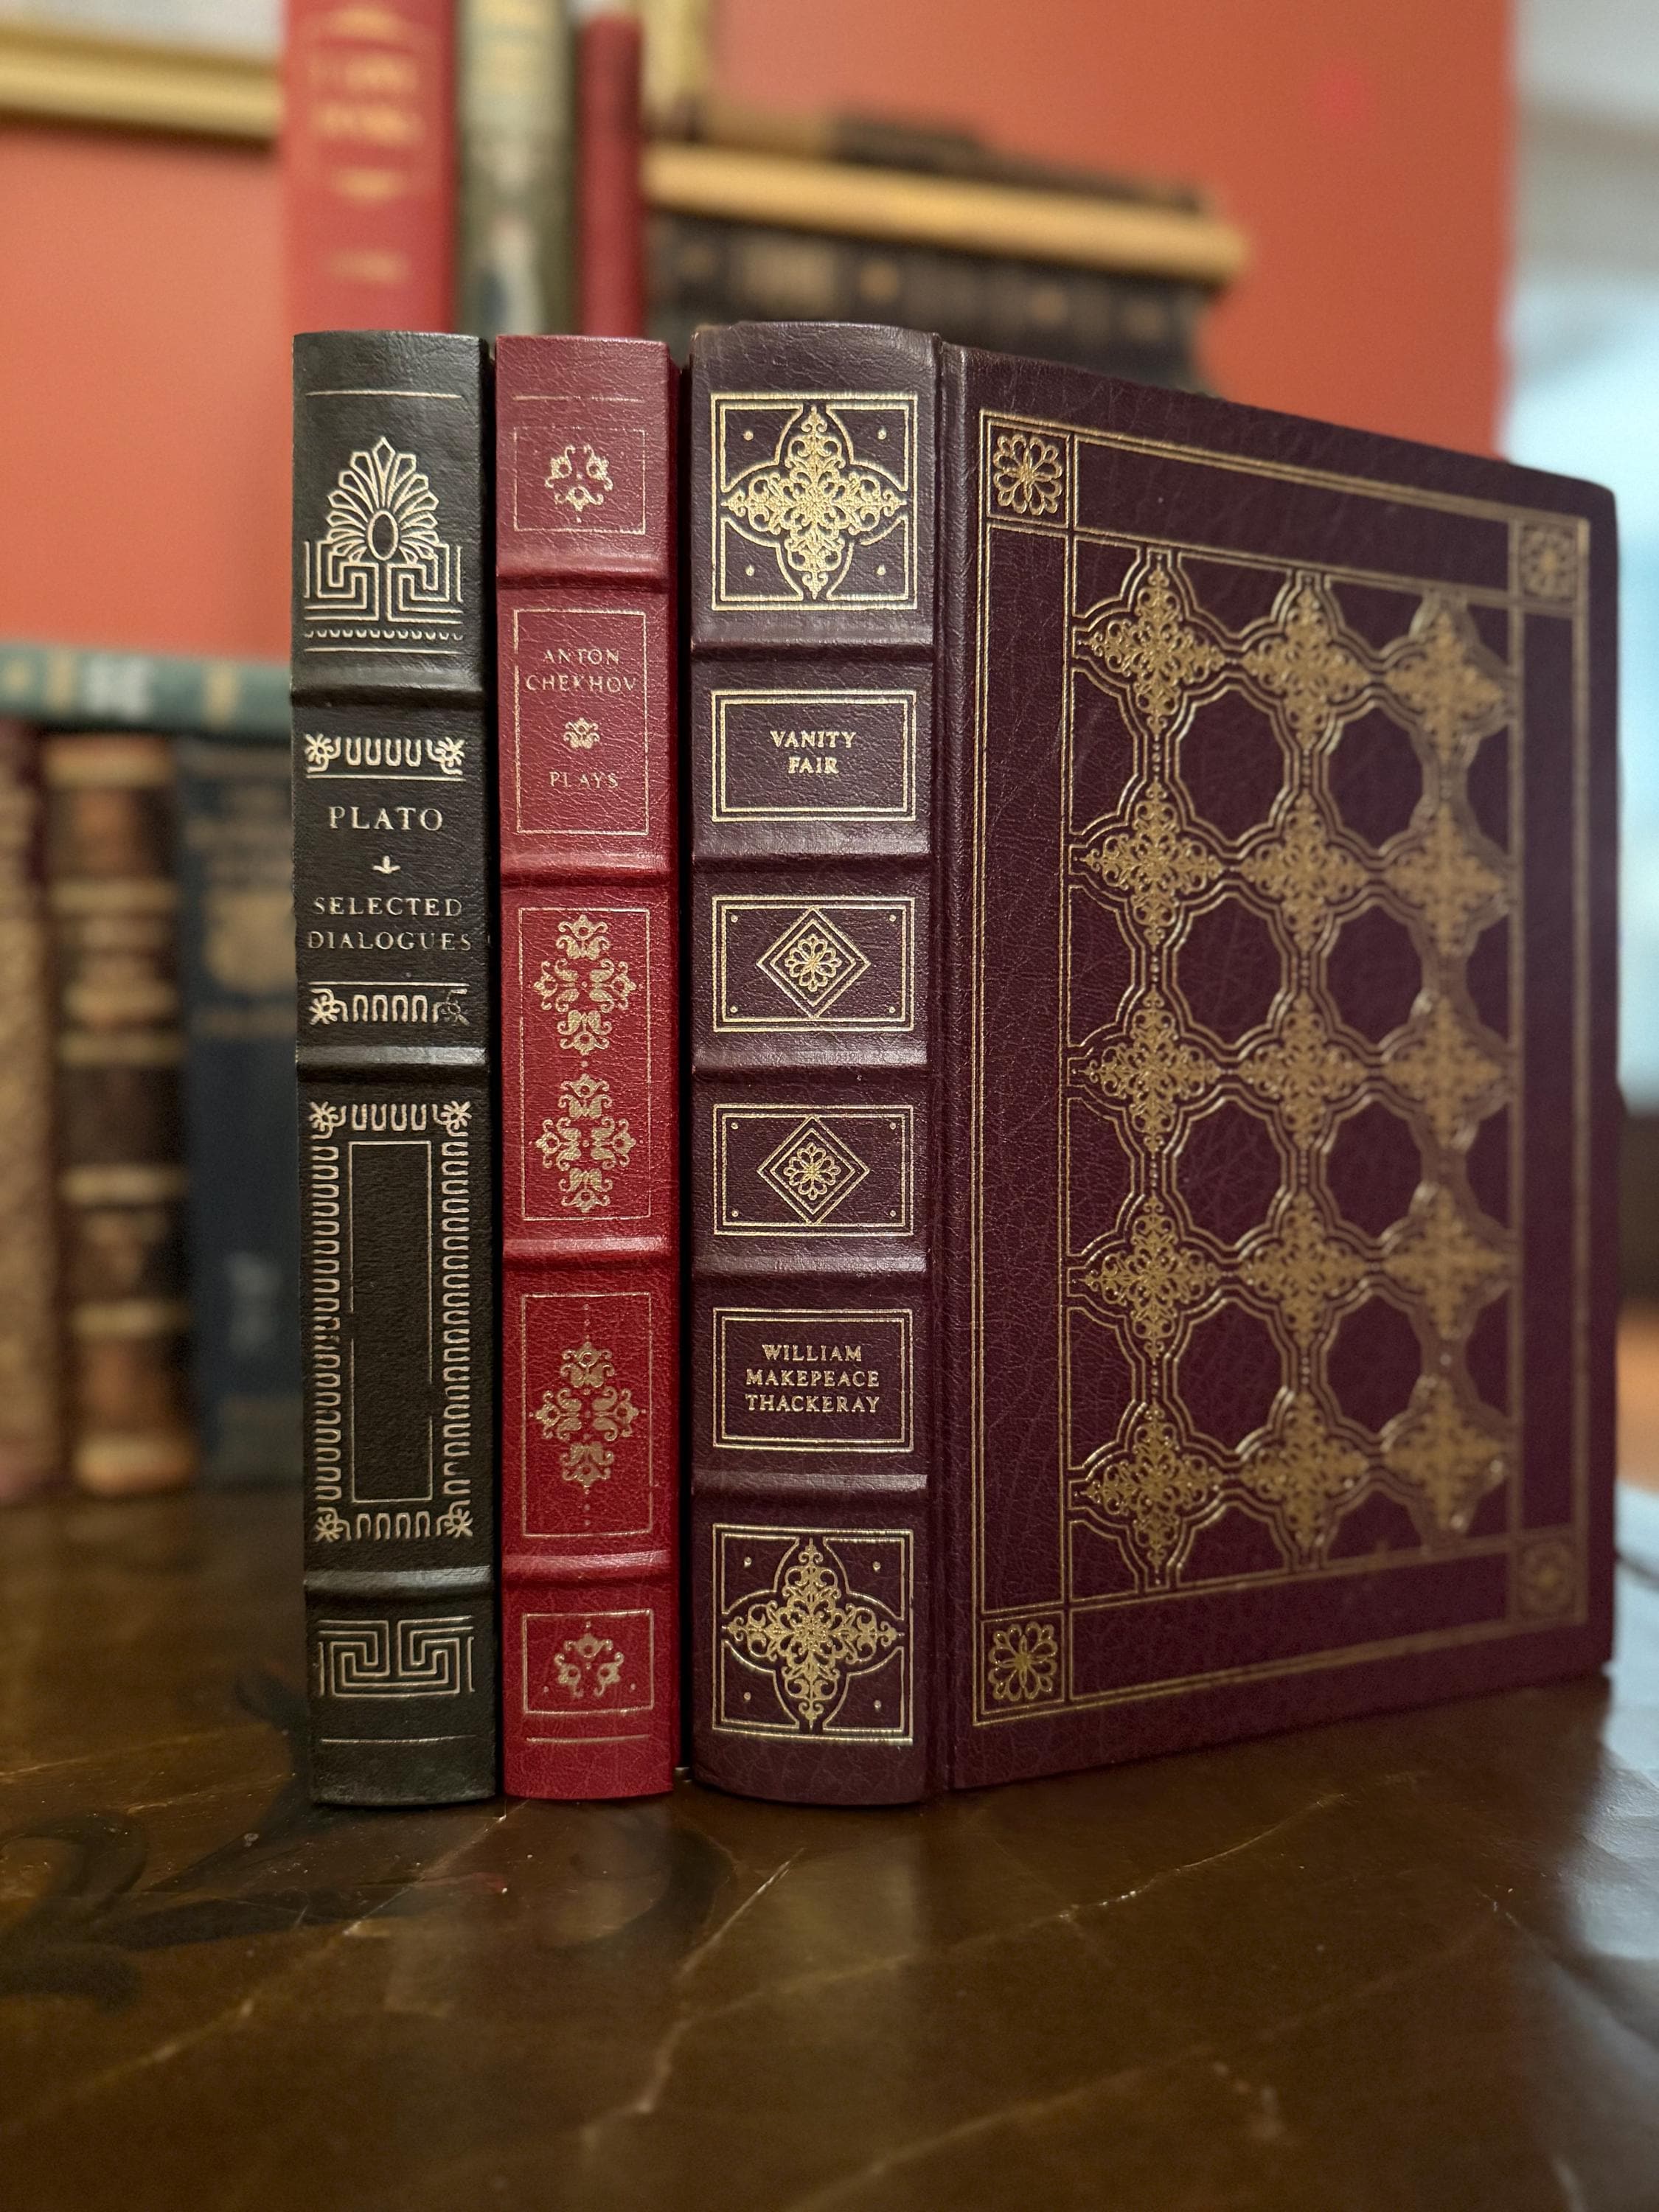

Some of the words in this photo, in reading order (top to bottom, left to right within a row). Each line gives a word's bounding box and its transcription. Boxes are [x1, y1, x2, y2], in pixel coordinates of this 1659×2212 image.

[543, 648, 620, 666] ANTON
[526, 674, 637, 693] CHEKHOV
[770, 729, 857, 748] VANITY
[787, 757, 840, 774] FAIR
[549, 771, 619, 789] PLAYS
[329, 805, 443, 832] PLATO
[312, 896, 463, 917] SELECTED
[306, 931, 473, 951] DIALOGUES
[762, 1343, 863, 1363] WILLIAM
[745, 1368, 880, 1388] MAKEPEACE
[745, 1394, 880, 1413] THACKERAY
